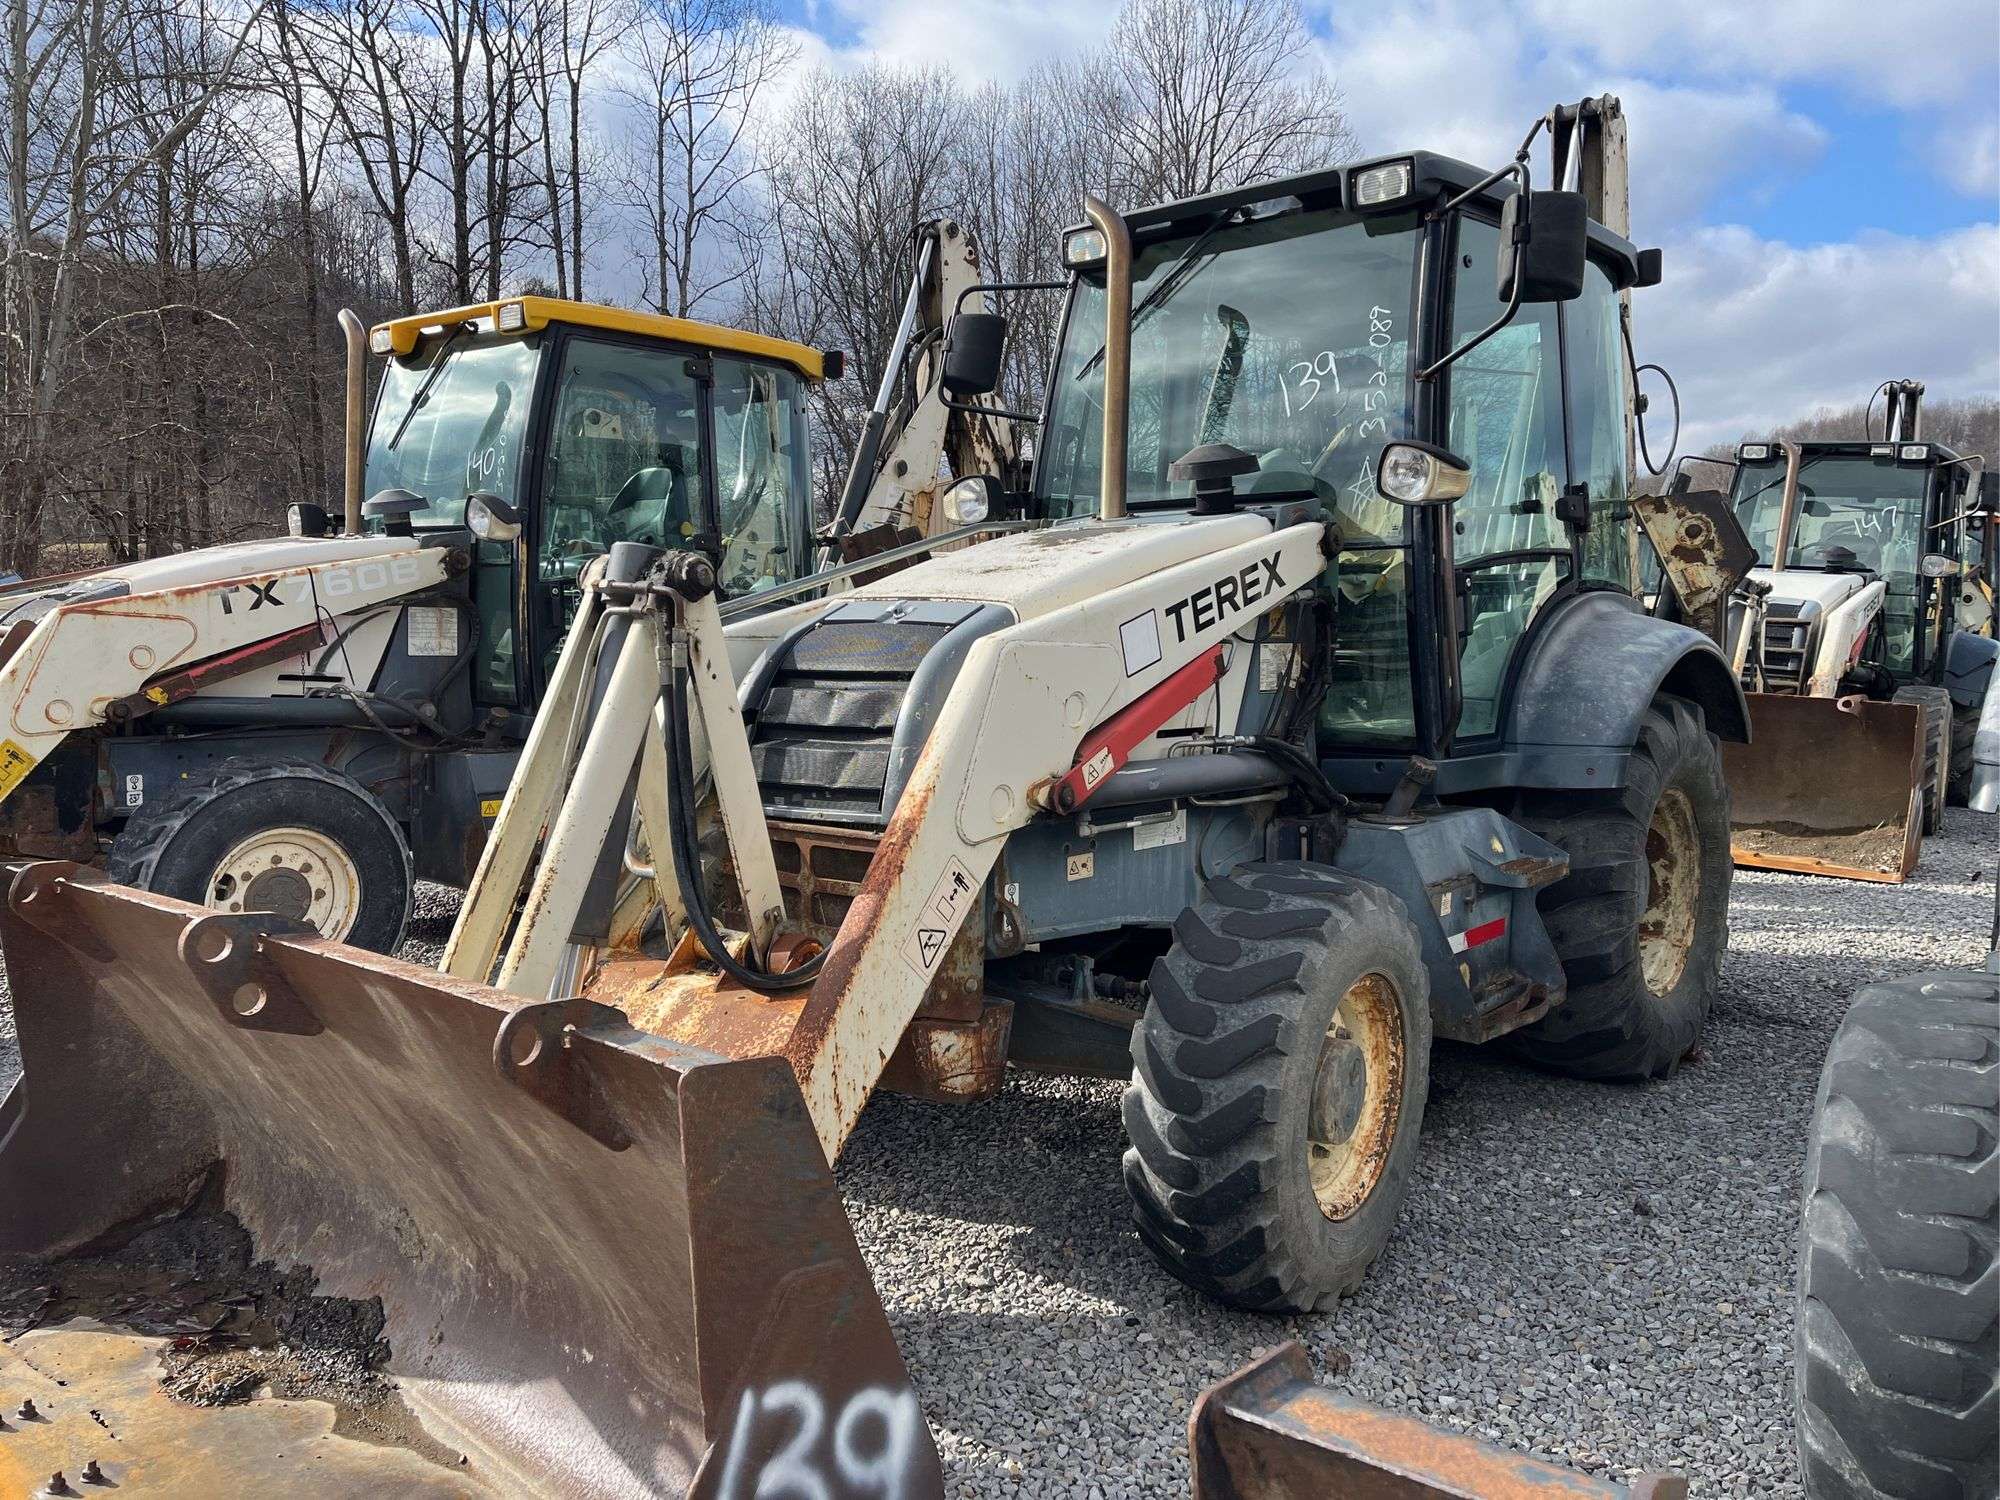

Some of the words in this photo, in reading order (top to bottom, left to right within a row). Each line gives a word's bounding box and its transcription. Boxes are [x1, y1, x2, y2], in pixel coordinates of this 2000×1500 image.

[1277, 350, 1341, 419] 139
[1358, 304, 1394, 439] 352-089
[465, 447, 496, 490] 140
[1853, 505, 1898, 539] 147
[1164, 549, 1287, 643] TEREX
